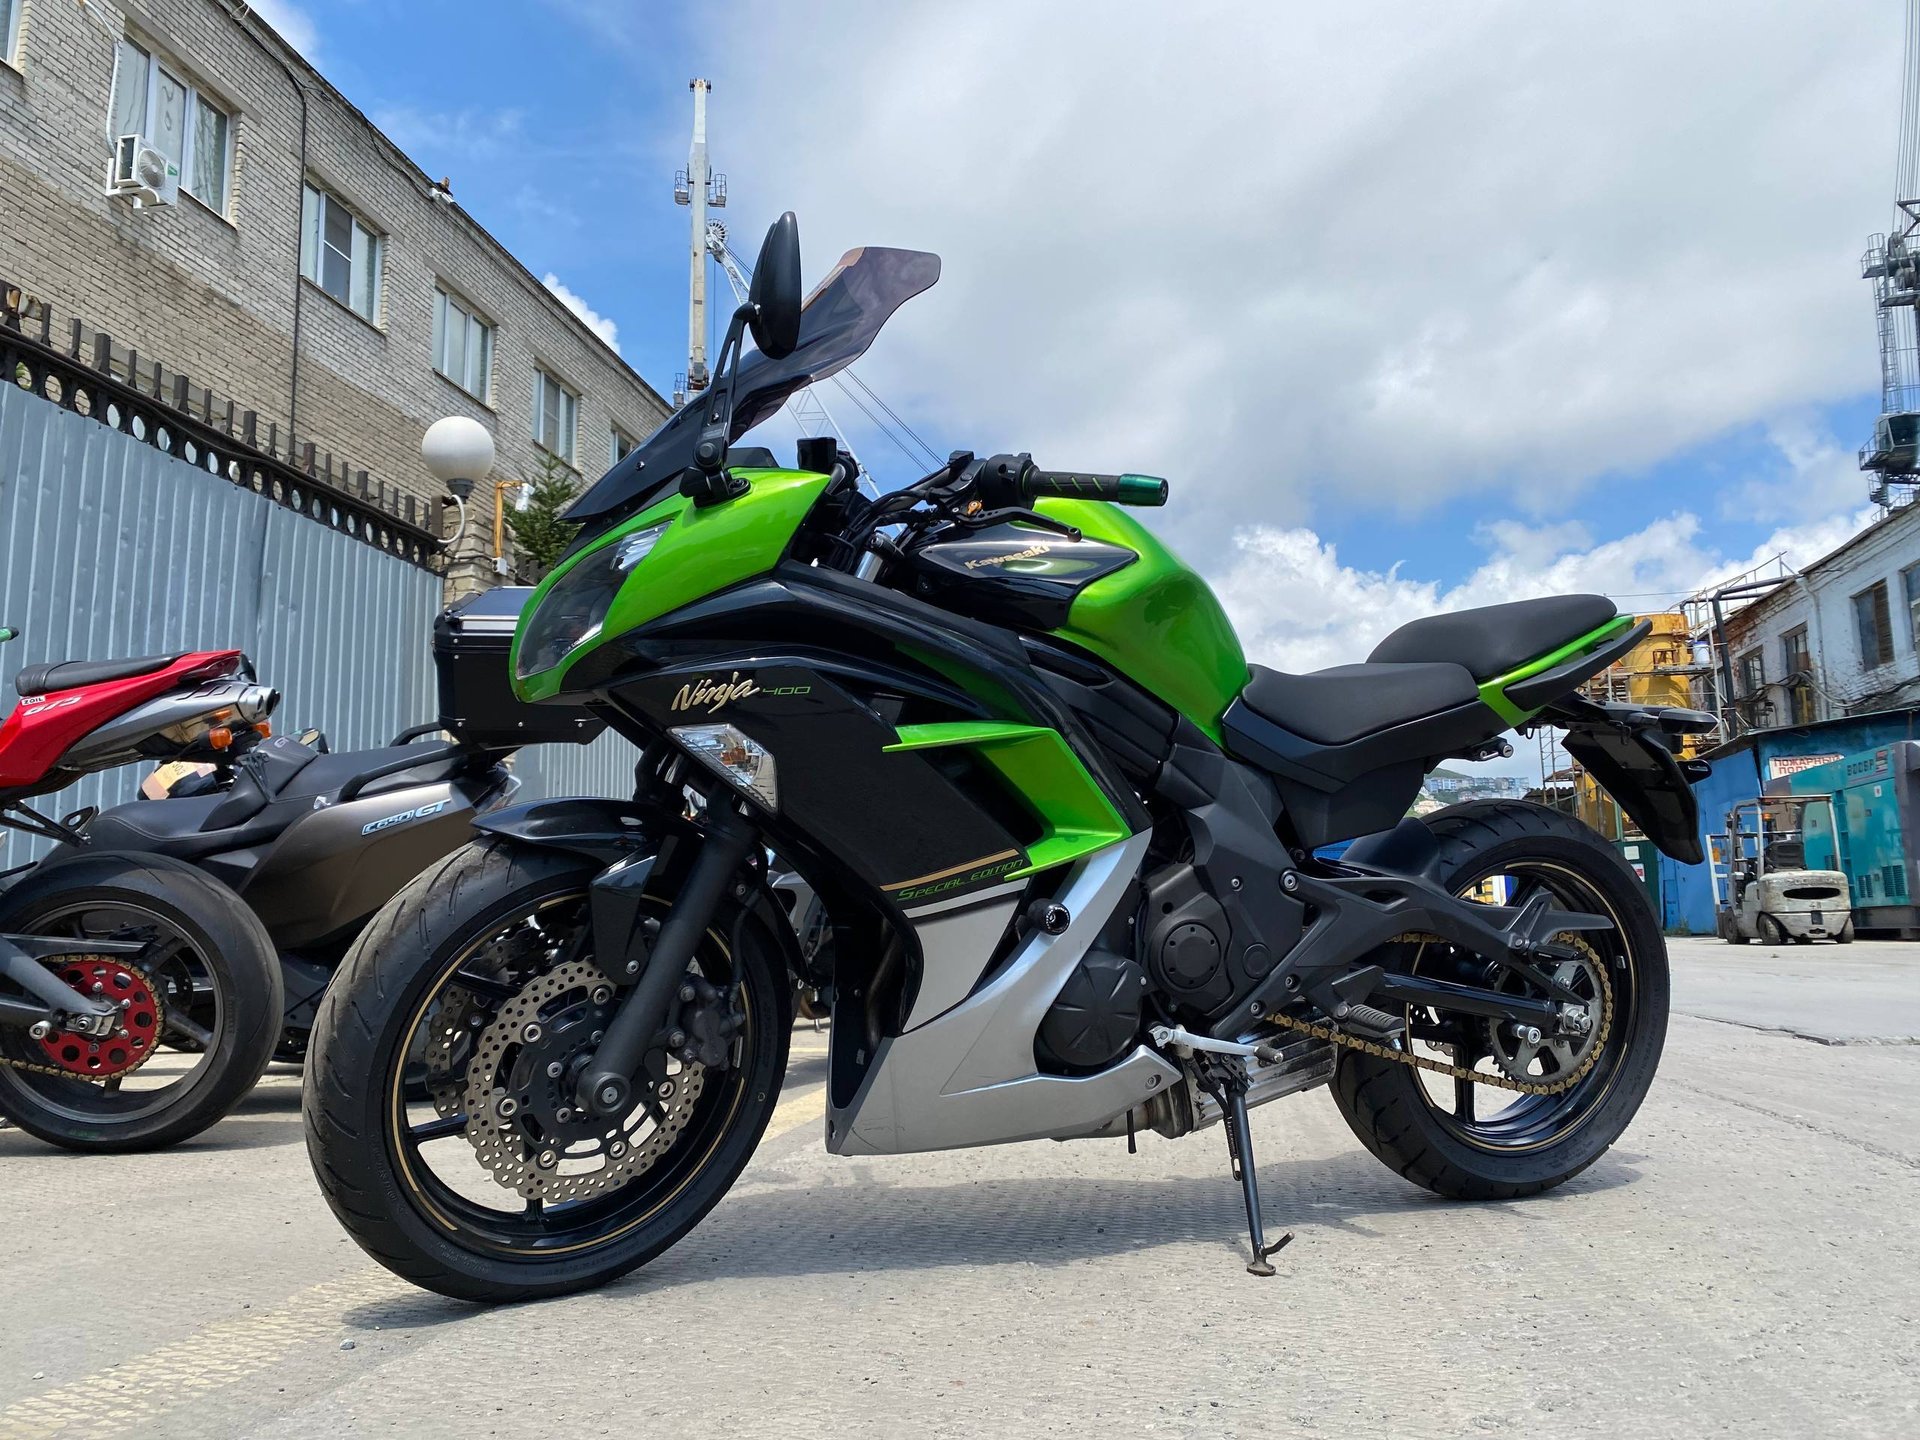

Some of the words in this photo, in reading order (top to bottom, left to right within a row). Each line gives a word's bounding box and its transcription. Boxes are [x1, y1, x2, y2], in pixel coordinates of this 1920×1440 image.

[964, 540, 1050, 570] Kawasaki
[670, 671, 760, 714] Ninja
[762, 686, 811, 695] 400
[363, 810, 414, 834] C650
[416, 799, 451, 818] GT
